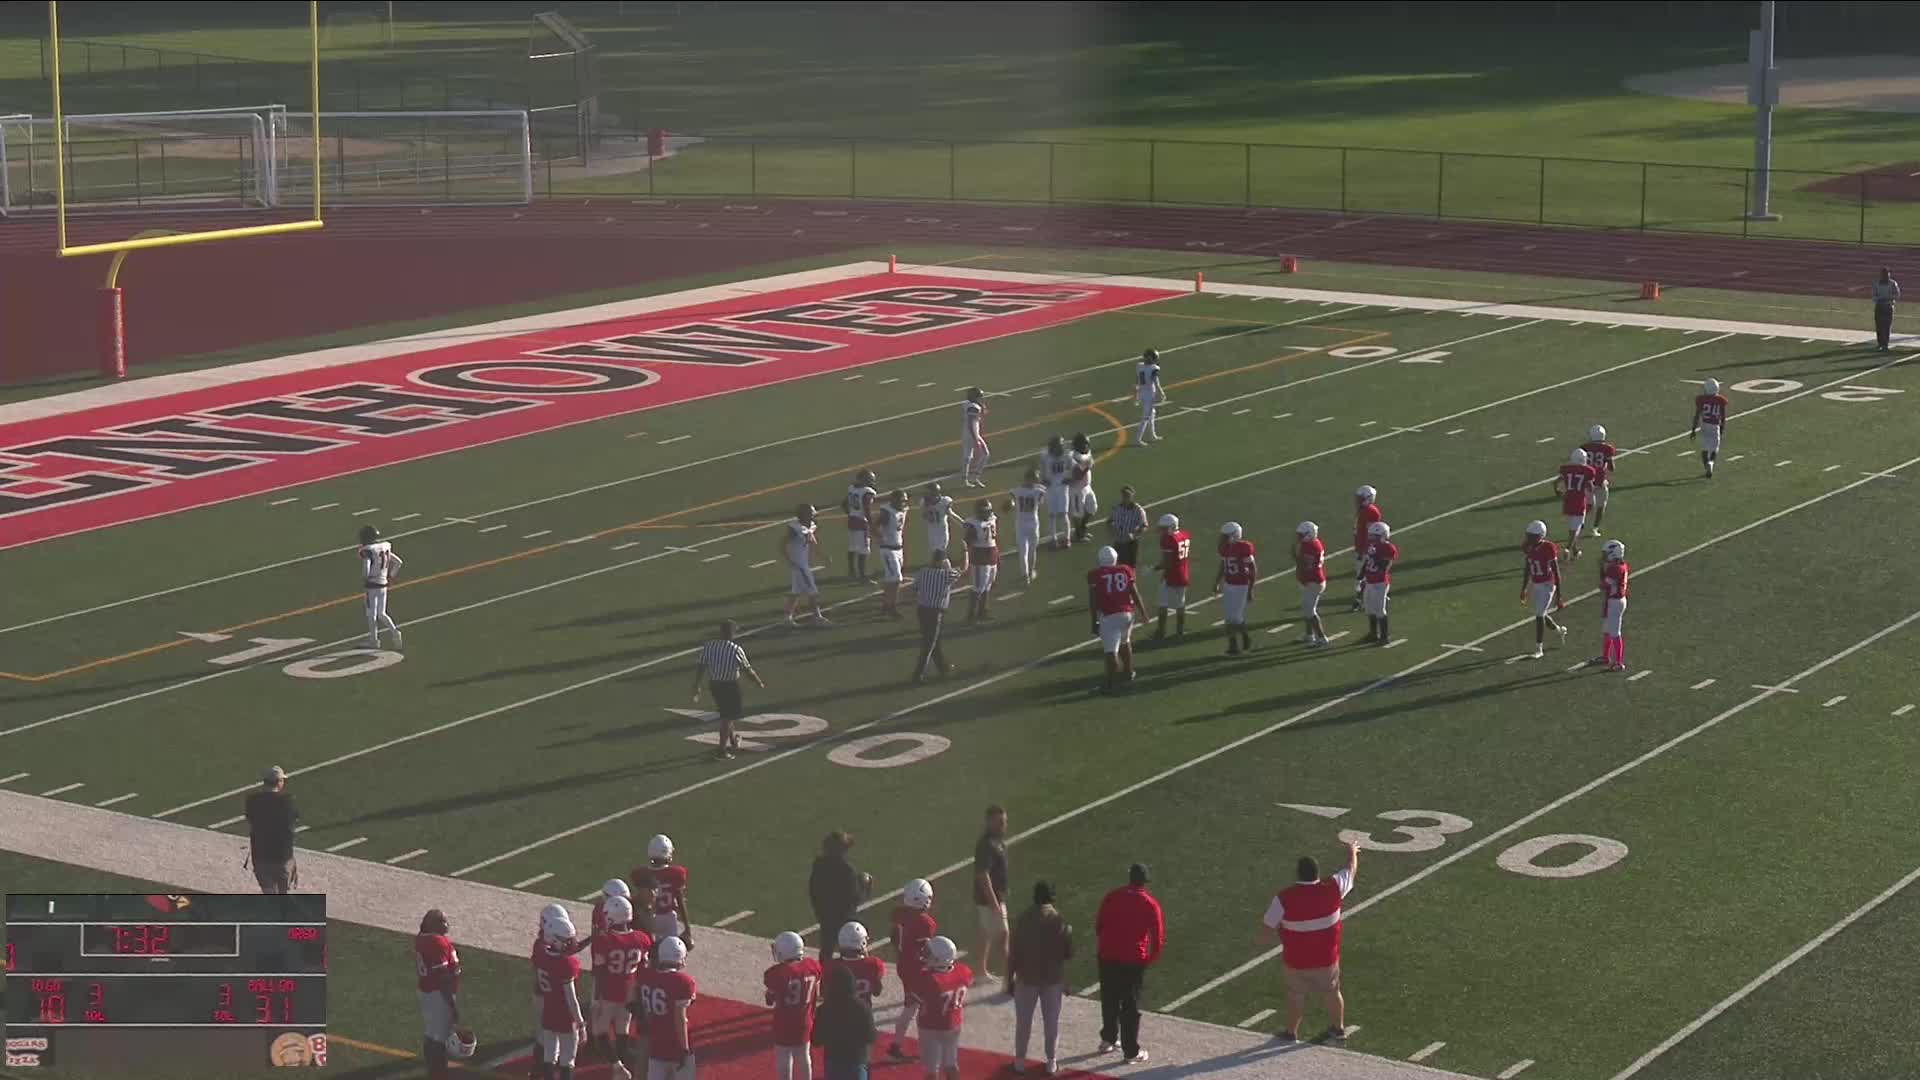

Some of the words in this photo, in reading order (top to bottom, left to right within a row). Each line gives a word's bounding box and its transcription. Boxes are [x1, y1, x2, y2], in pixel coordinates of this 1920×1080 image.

[1703, 404, 1720, 418] 24
[1567, 474, 1584, 491] 17
[1102, 572, 1127, 593] 78
[608, 949, 641, 975] 32
[641, 984, 667, 1015] 66
[784, 974, 817, 1005] 37
